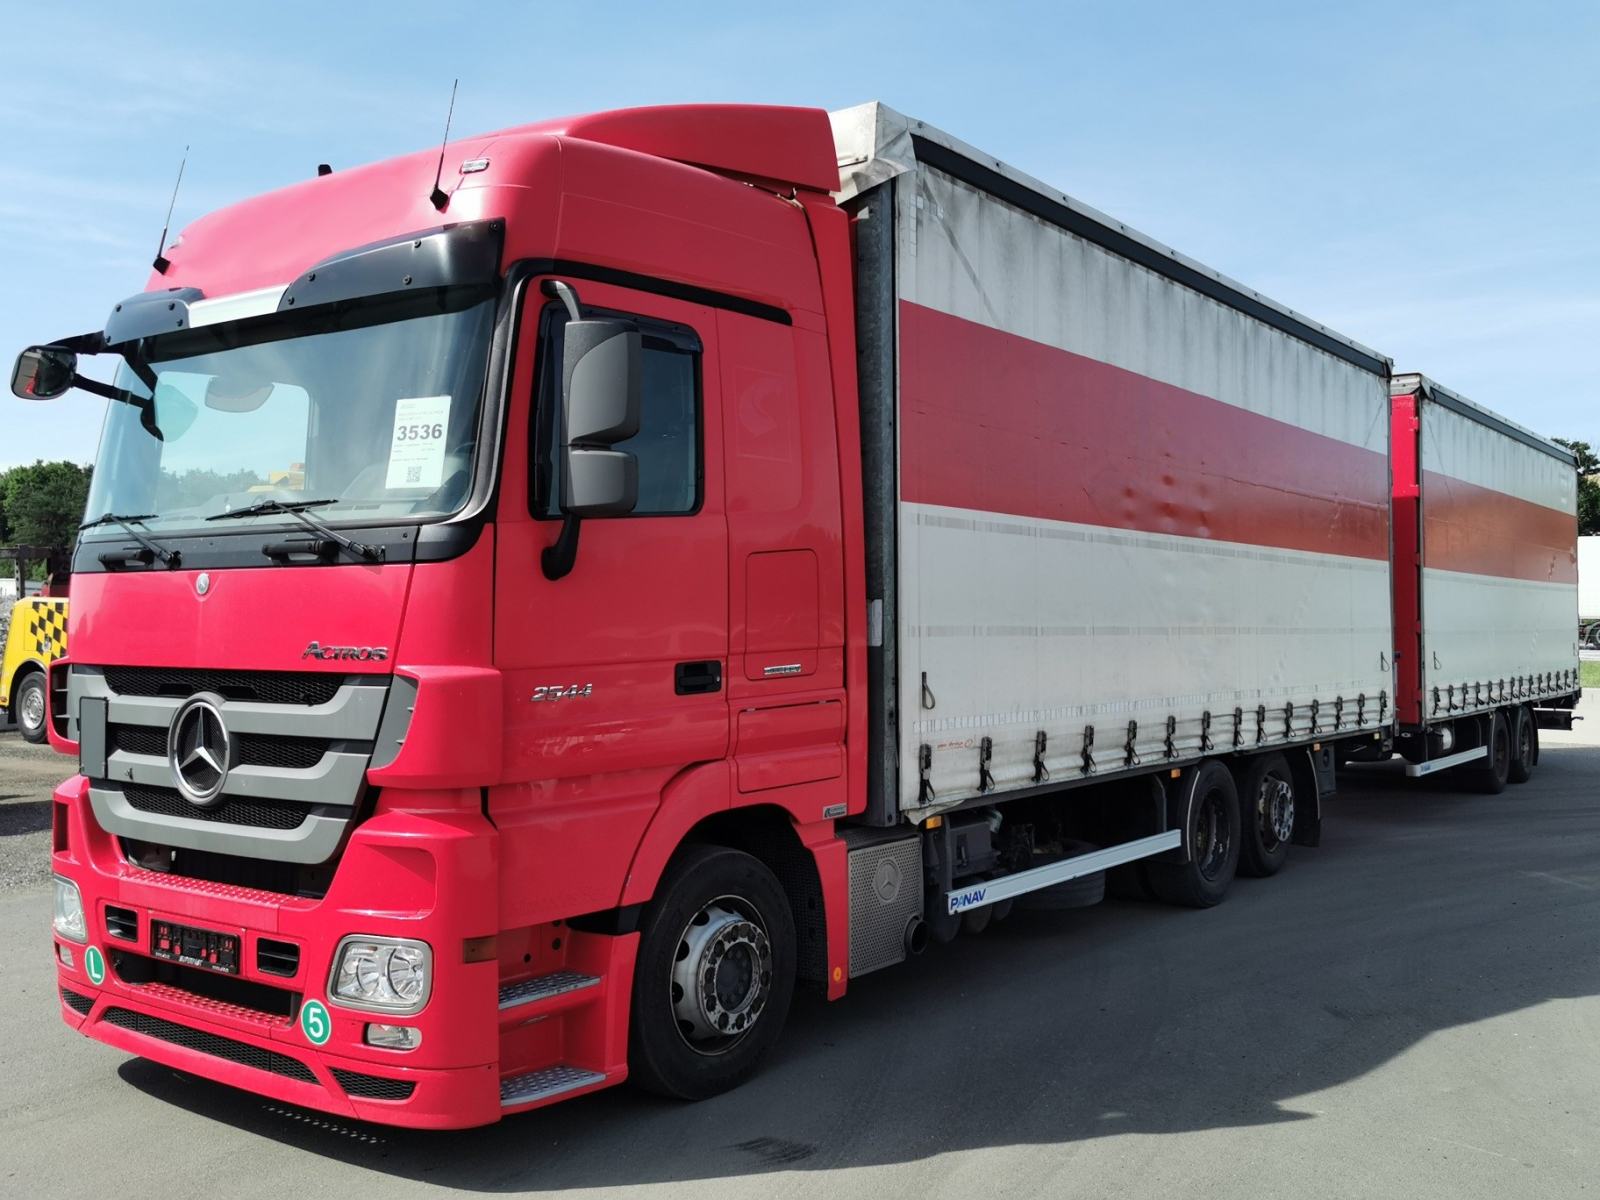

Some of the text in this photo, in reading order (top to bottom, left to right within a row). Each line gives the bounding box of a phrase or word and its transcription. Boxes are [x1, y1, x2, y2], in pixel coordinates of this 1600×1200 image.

[397, 423, 443, 441] 3536
[531, 684, 593, 702] 2544
[950, 888, 986, 911] PANAV
[90, 950, 102, 979] L
[309, 1007, 324, 1038] 5
